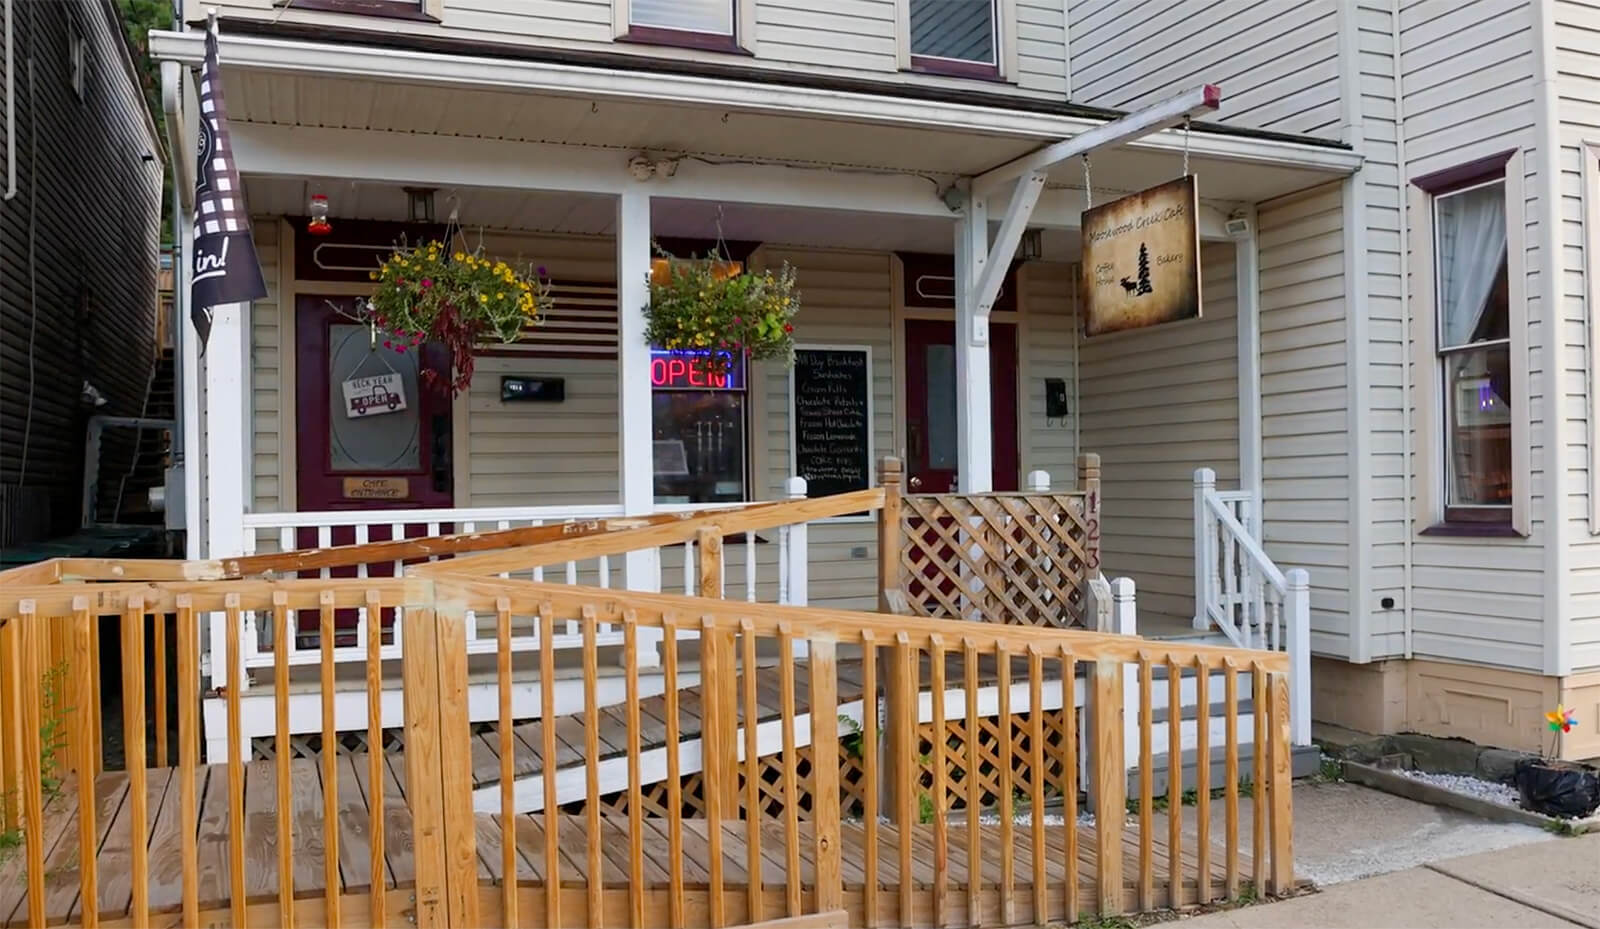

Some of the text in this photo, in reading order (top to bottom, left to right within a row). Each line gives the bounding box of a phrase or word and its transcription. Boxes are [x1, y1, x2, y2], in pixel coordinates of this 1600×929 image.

[1088, 222, 1134, 242] Moosewood
[1135, 213, 1161, 230] Creek
[196, 236, 229, 272] in!
[1156, 253, 1184, 267] Bakery
[1095, 262, 1114, 275] Coffee
[373, 376, 393, 385] YEAH
[651, 358, 726, 387] OPEN
[361, 393, 388, 407] OPEN
[1087, 491, 1100, 569] 123
